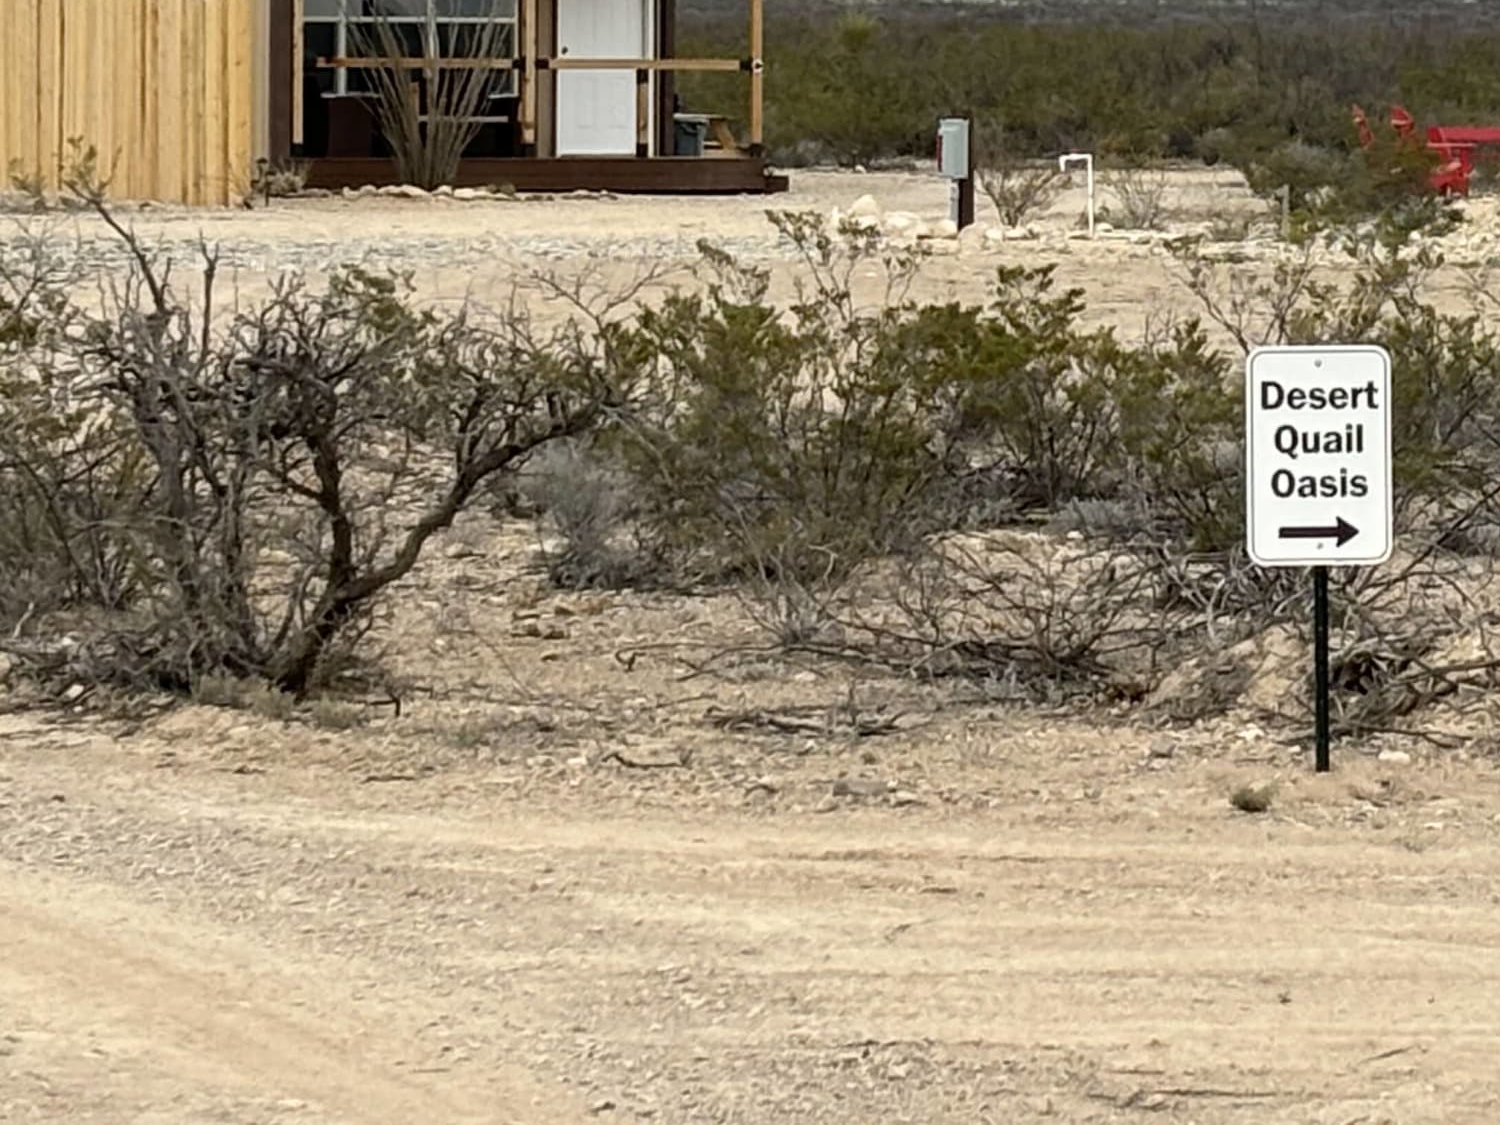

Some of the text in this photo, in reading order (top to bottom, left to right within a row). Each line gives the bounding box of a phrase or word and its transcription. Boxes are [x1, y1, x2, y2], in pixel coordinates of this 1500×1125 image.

[1261, 381, 1379, 410] Desert
[1274, 423, 1364, 460] Quail
[1271, 467, 1368, 498] Oasis
